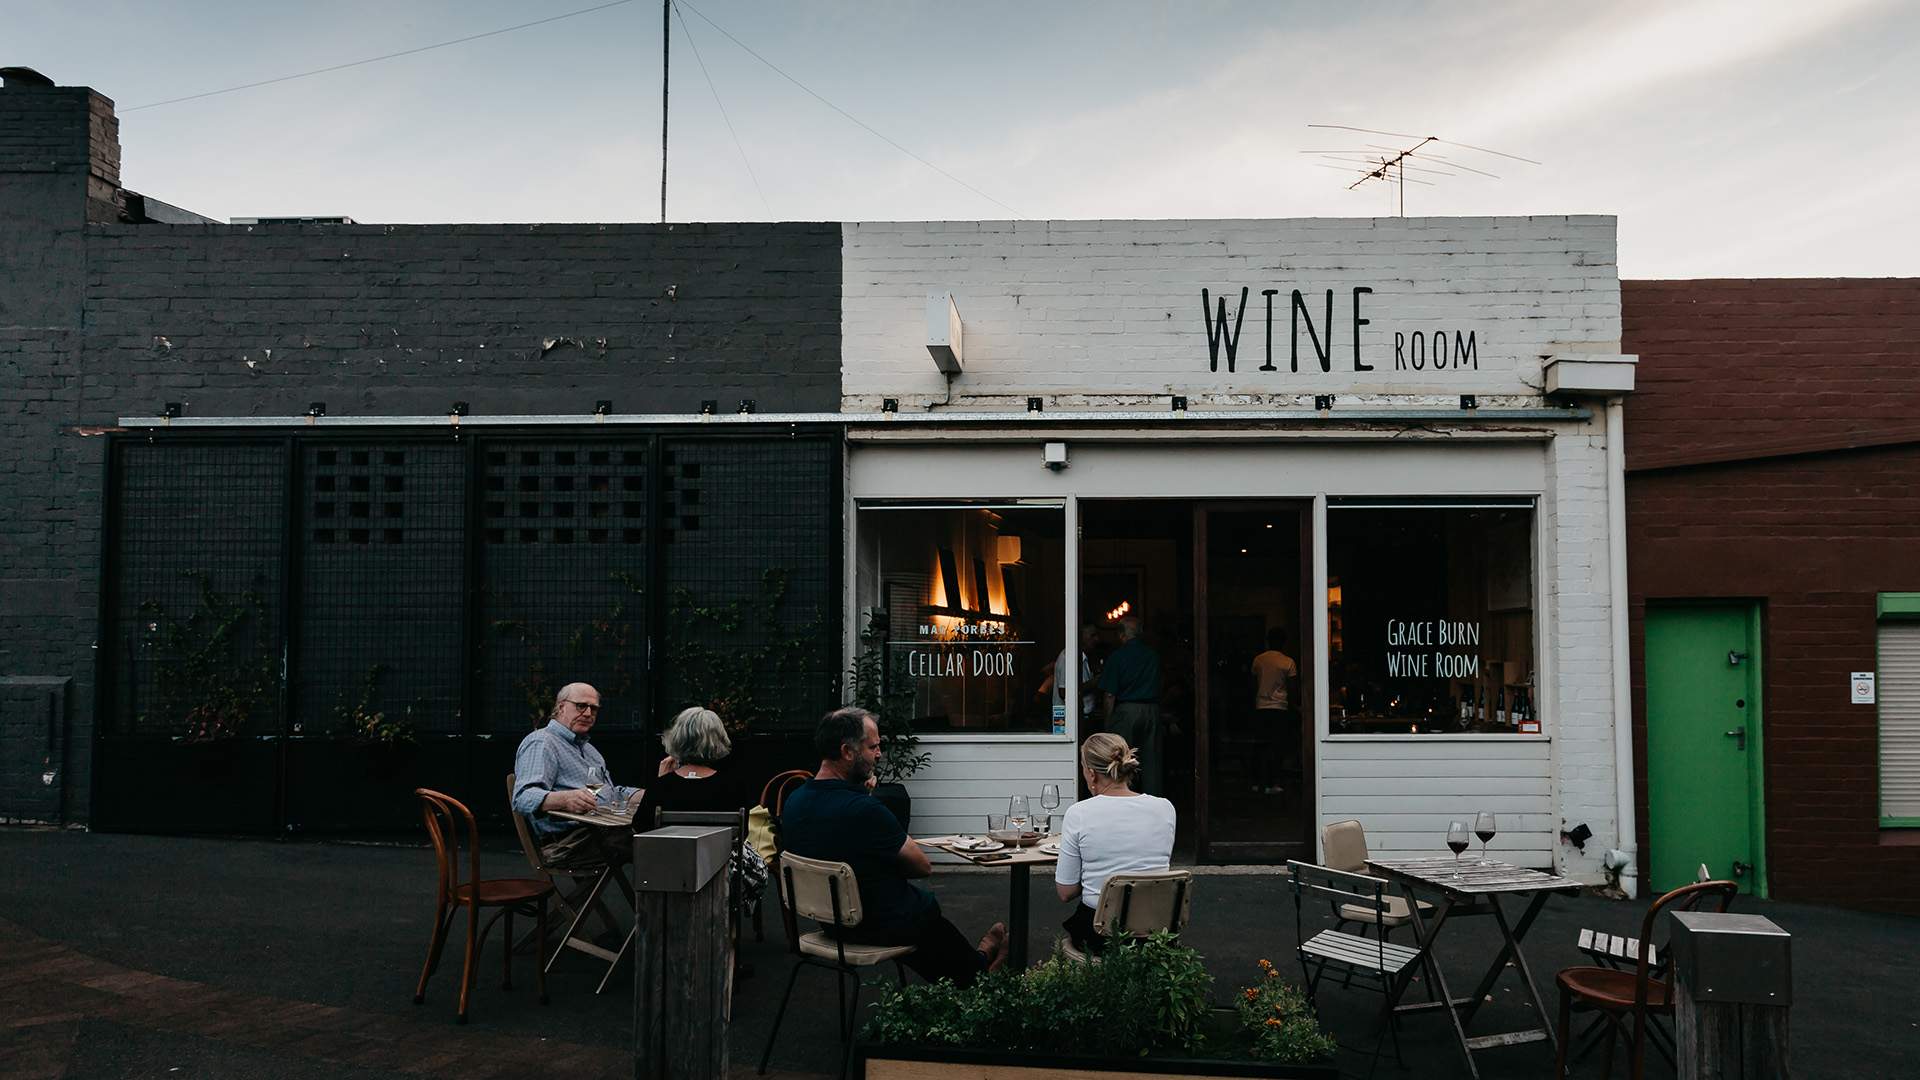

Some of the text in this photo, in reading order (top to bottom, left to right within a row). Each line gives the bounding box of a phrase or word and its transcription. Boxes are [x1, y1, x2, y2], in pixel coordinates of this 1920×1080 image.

[1201, 286, 1478, 373] WINE ROOM
[1388, 618, 1480, 646] GRACE BURN
[908, 650, 1014, 677] CELLAR DOOR
[1387, 652, 1479, 679] WINE ROOM
